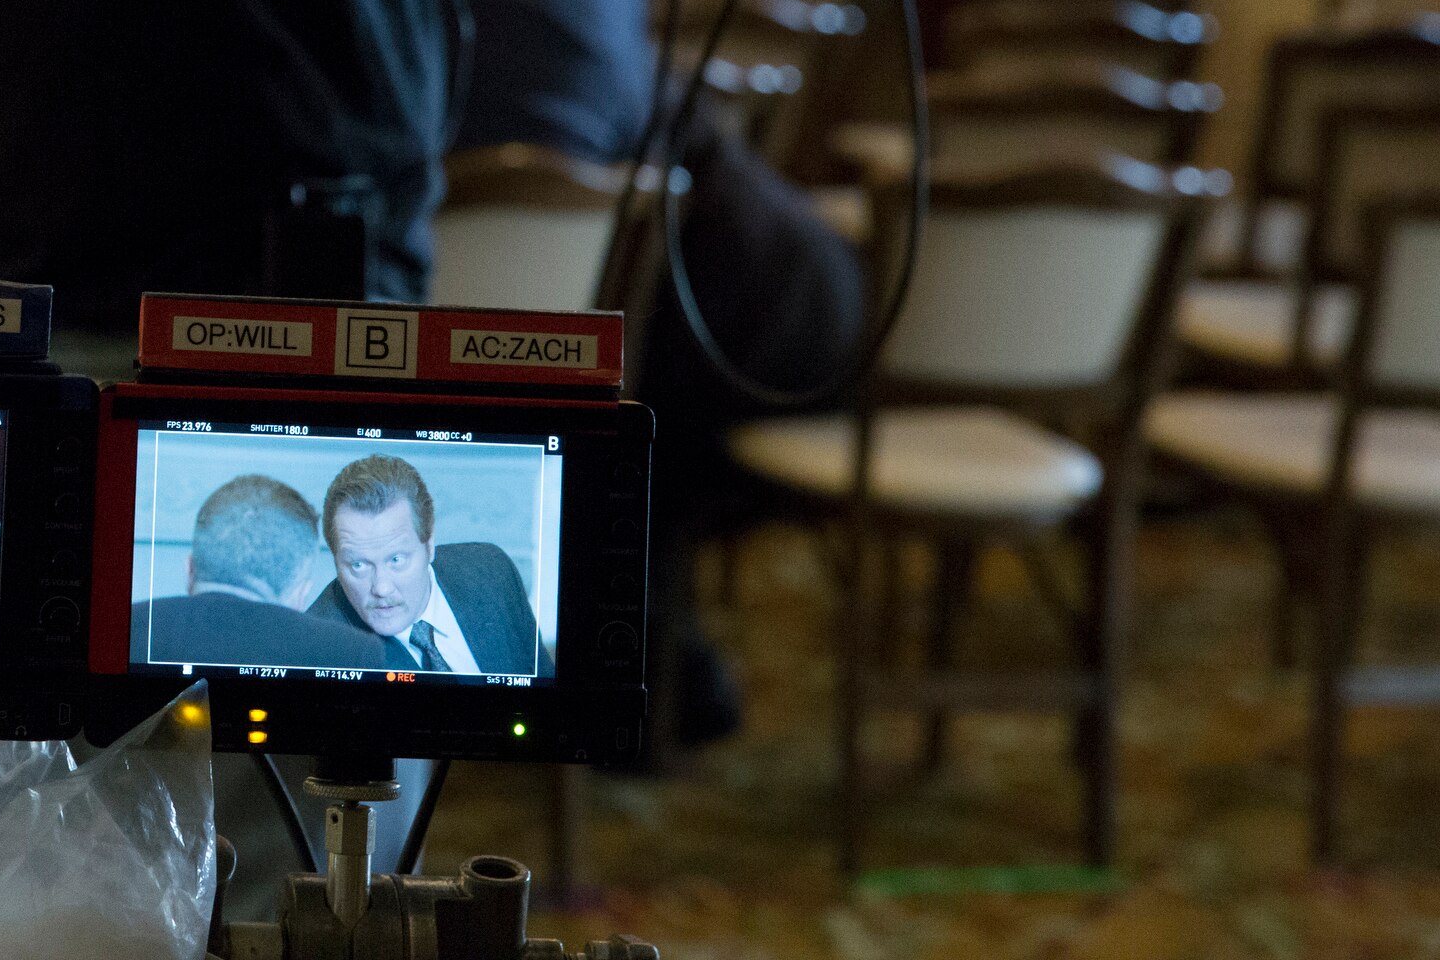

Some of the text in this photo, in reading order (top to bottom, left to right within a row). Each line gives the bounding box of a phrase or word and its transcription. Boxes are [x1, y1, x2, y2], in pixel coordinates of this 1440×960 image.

[186, 321, 298, 350] OP:WILL
[365, 325, 389, 360] B
[462, 335, 582, 363] AC:ZACH
[166, 420, 212, 432] FPS 23.976
[250, 424, 309, 436] SHUTTER 180.0
[364, 428, 382, 438] 400
[415, 430, 473, 442] WB 3800 CC +0
[548, 435, 559, 451] B
[239, 667, 254, 675] BAT
[315, 670, 330, 678] BAT
[397, 672, 416, 683] REC
